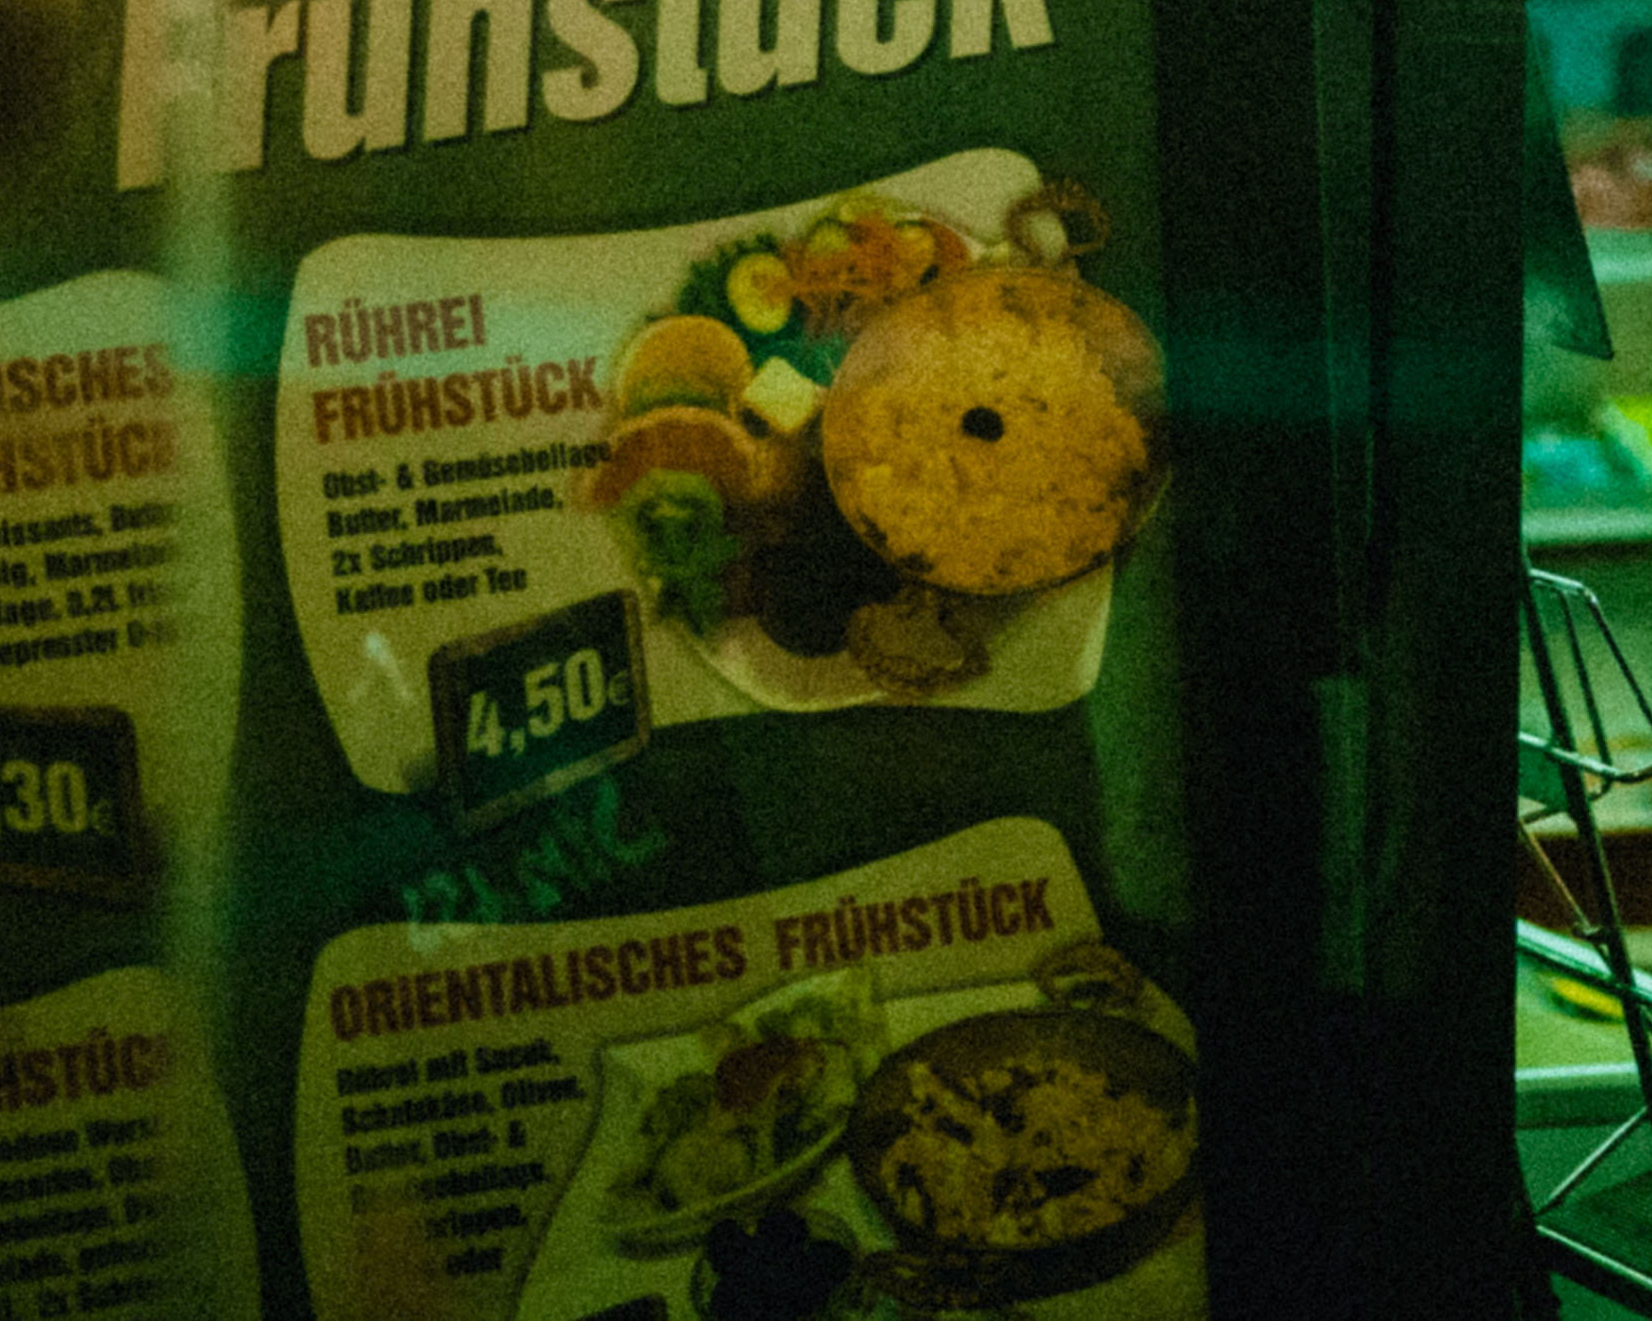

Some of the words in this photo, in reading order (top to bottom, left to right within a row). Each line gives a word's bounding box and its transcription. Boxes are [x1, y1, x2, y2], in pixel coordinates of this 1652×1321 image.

[304, 293, 487, 367] RÜHREI
[312, 356, 604, 445] FRÜHSTÜCK
[332, 548, 363, 579] 2x
[485, 566, 528, 594] Tee
[330, 926, 746, 1042] ORIENTALISCHES
[774, 878, 1055, 971] FRÜHSTÜCK
